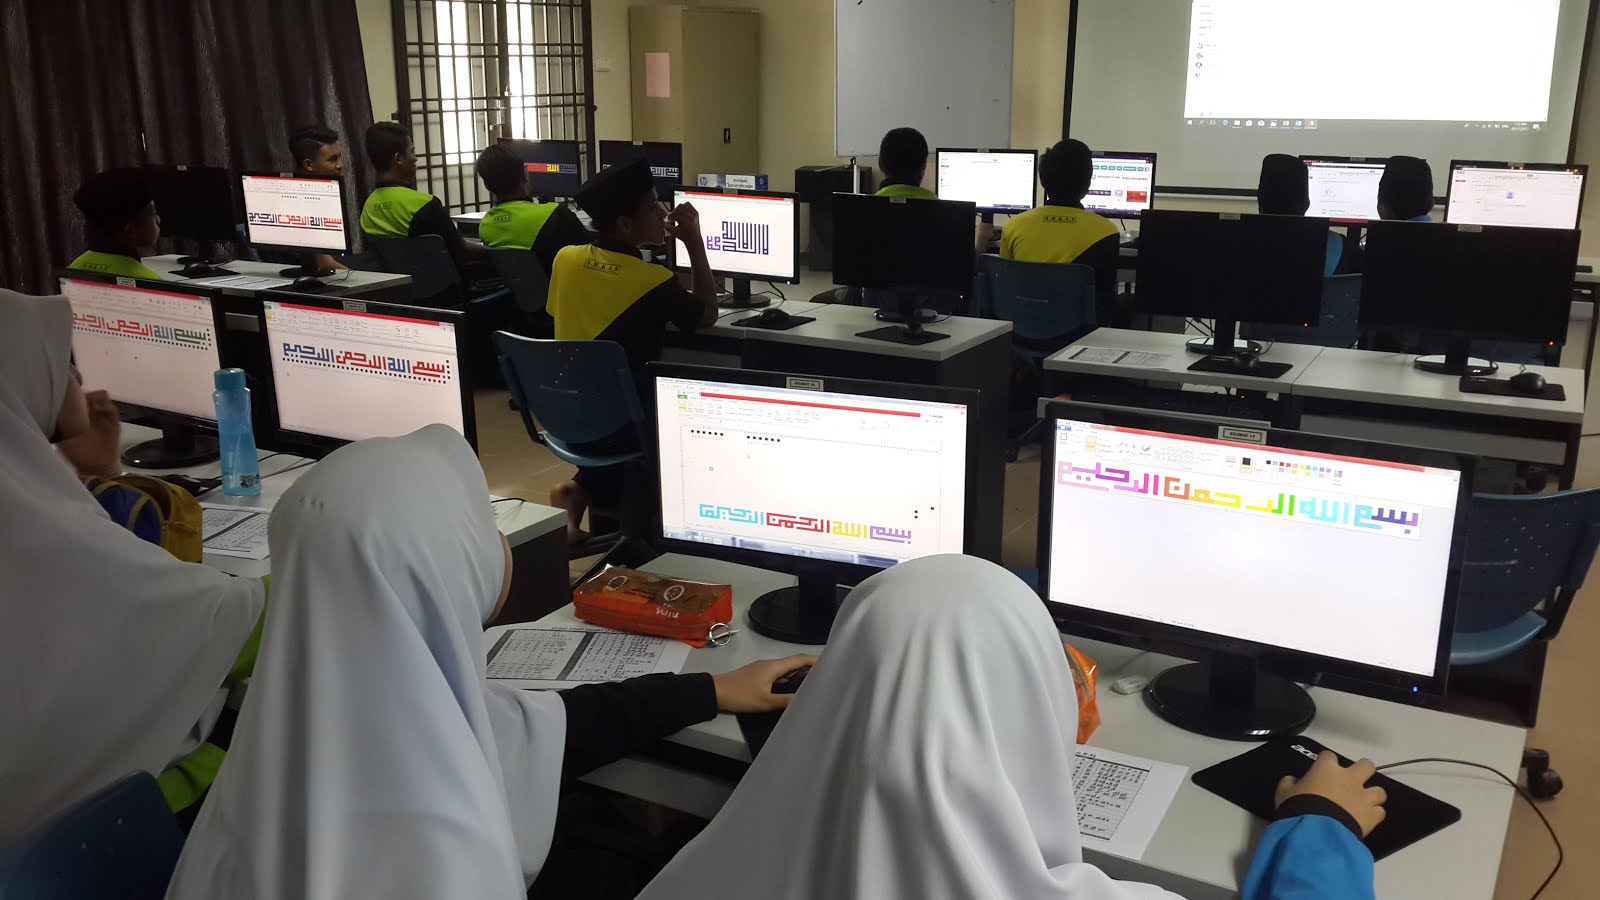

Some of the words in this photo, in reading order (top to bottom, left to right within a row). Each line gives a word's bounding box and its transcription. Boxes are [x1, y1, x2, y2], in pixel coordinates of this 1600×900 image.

[309, 216, 323, 226] الله
[323, 217, 342, 228] بسم
[106, 319, 153, 337] الرحمن
[153, 325, 174, 340] الله
[174, 328, 207, 346] بسم
[282, 342, 335, 363] الرحيم
[336, 350, 388, 370] الرحمن
[387, 357, 411, 373] الله
[412, 361, 446, 379] بسم
[1058, 460, 1160, 496] الرحيم
[1299, 497, 1350, 525] الله
[1353, 504, 1419, 535] بسم
[766, 512, 831, 534] الرحمن
[832, 520, 868, 539] الله
[869, 525, 912, 544] بسم
[1290, 744, 1318, 761] ace
